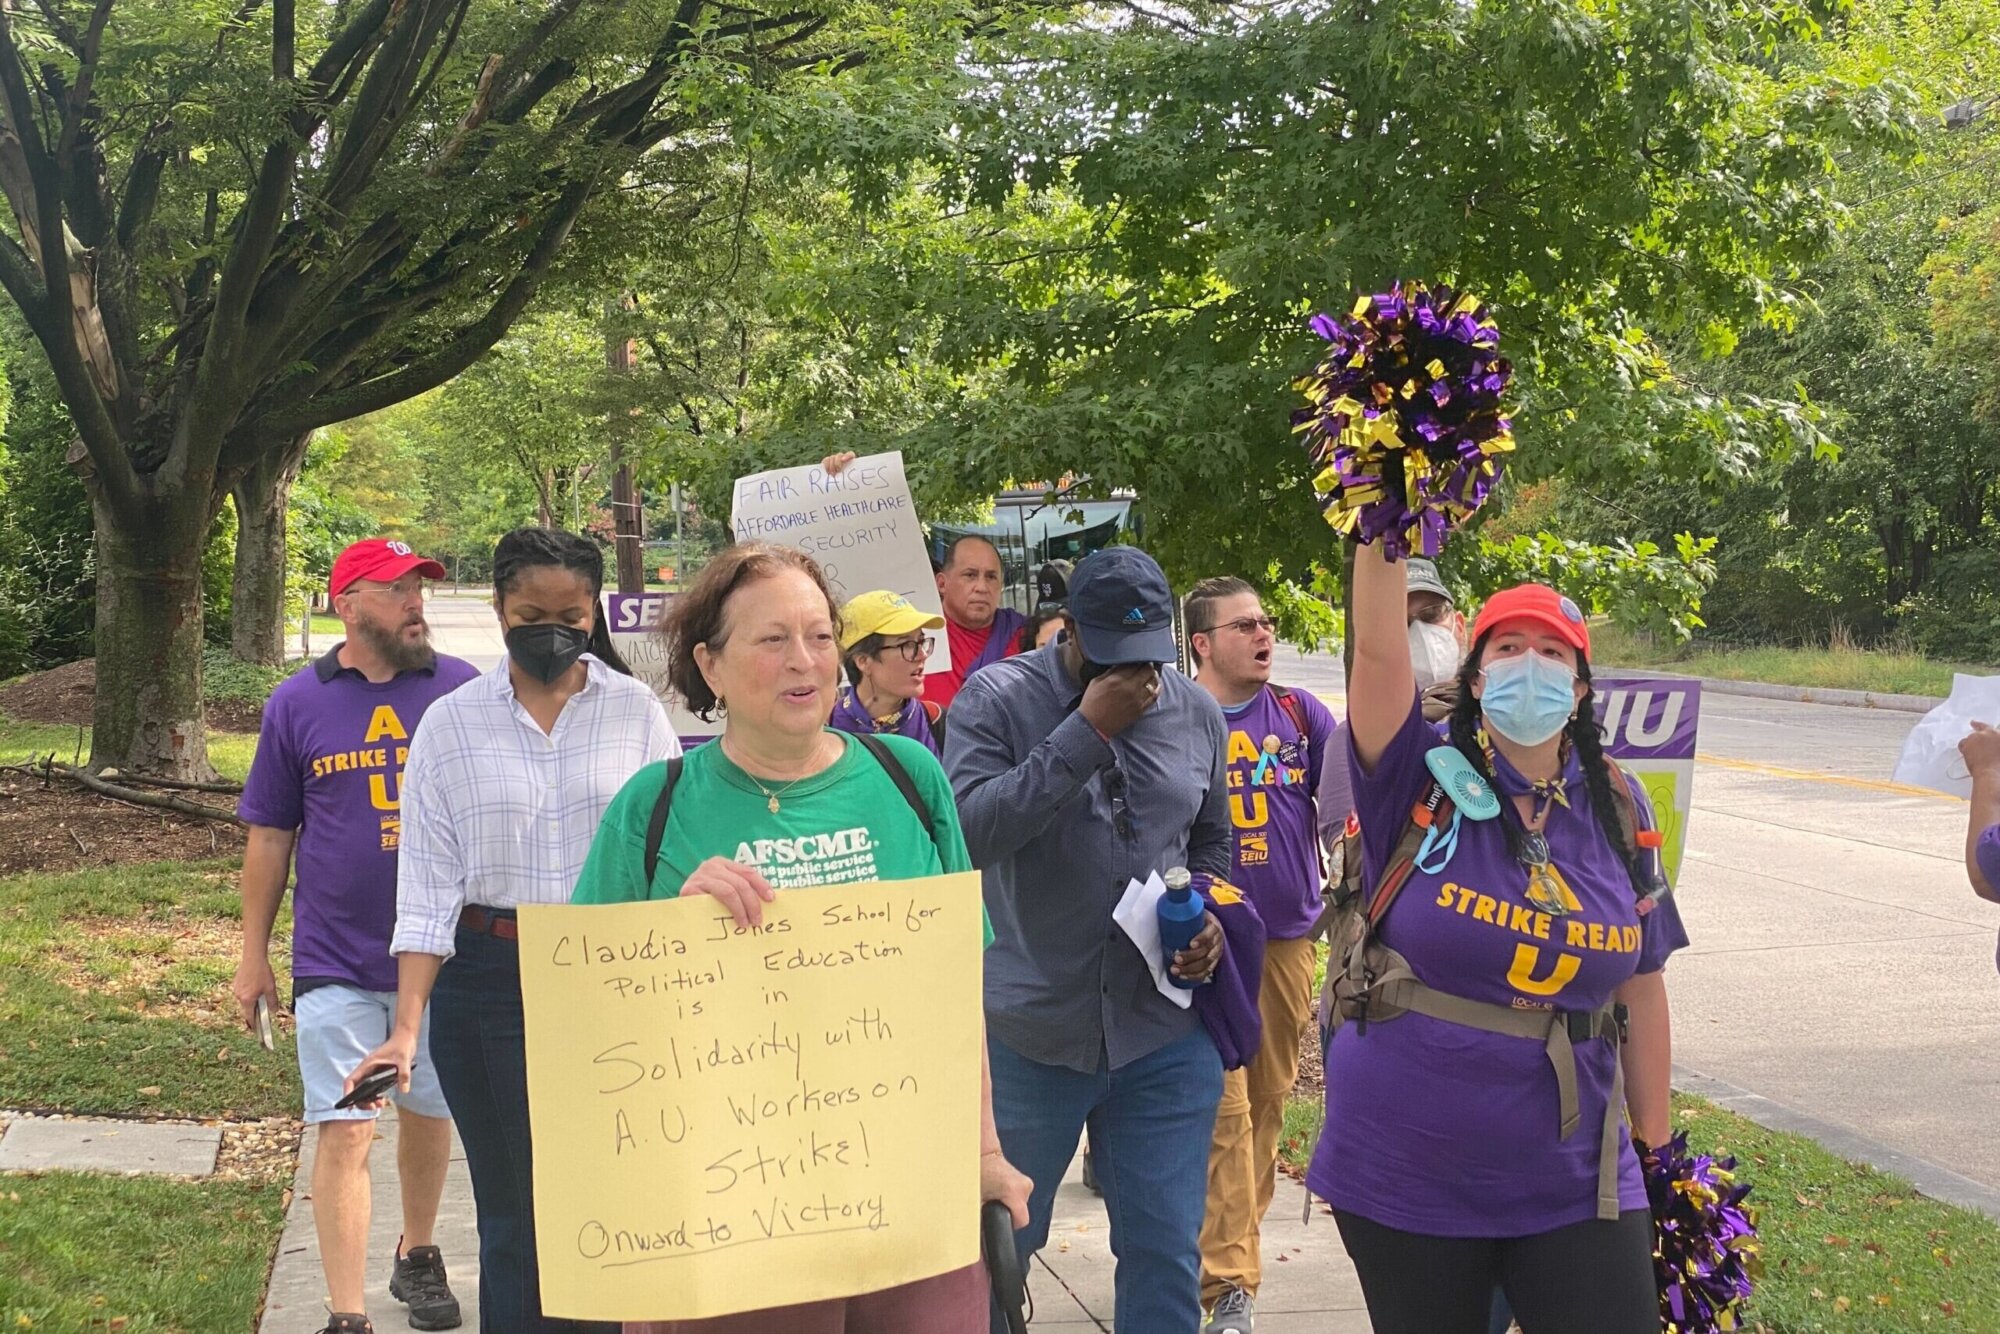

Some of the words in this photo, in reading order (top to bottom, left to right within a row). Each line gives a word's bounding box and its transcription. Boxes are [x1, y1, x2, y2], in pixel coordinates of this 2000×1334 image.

[740, 476, 799, 507] FAIR
[809, 465, 890, 495] RAISES
[736, 510, 819, 541] AFFORDABLE
[824, 495, 907, 521] HEALTHCARE
[799, 519, 898, 555] SECURITY
[617, 598, 664, 628] SE
[364, 704, 408, 743] A
[1593, 690, 1686, 748] IU
[312, 748, 387, 777] STRIKE
[1226, 730, 1260, 765] A
[368, 771, 405, 810] U
[1251, 768, 1307, 785] EDY
[1229, 792, 1269, 829] U
[381, 836, 399, 847] SE
[1240, 851, 1268, 862] SEIU
[755, 865, 776, 876] he
[777, 862, 823, 878] public
[823, 853, 874, 871] service
[825, 864, 877, 883] service
[552, 929, 687, 966] Claudia
[706, 917, 792, 942] Jones
[822, 902, 890, 926] School
[906, 899, 942, 932] for
[1436, 882, 1552, 939] STRIKE
[1566, 920, 1640, 953] READY
[604, 960, 724, 998] Political
[764, 941, 902, 971] Education
[1506, 942, 1582, 996] U
[677, 1000, 704, 1019] is
[761, 987, 788, 1005] in
[592, 1021, 800, 1093] Solidarity
[826, 1008, 892, 1045] with
[727, 1080, 860, 1126] Workers
[578, 1220, 694, 1258] Onward
[694, 1217, 731, 1244] to
[753, 1194, 884, 1240] Victory
